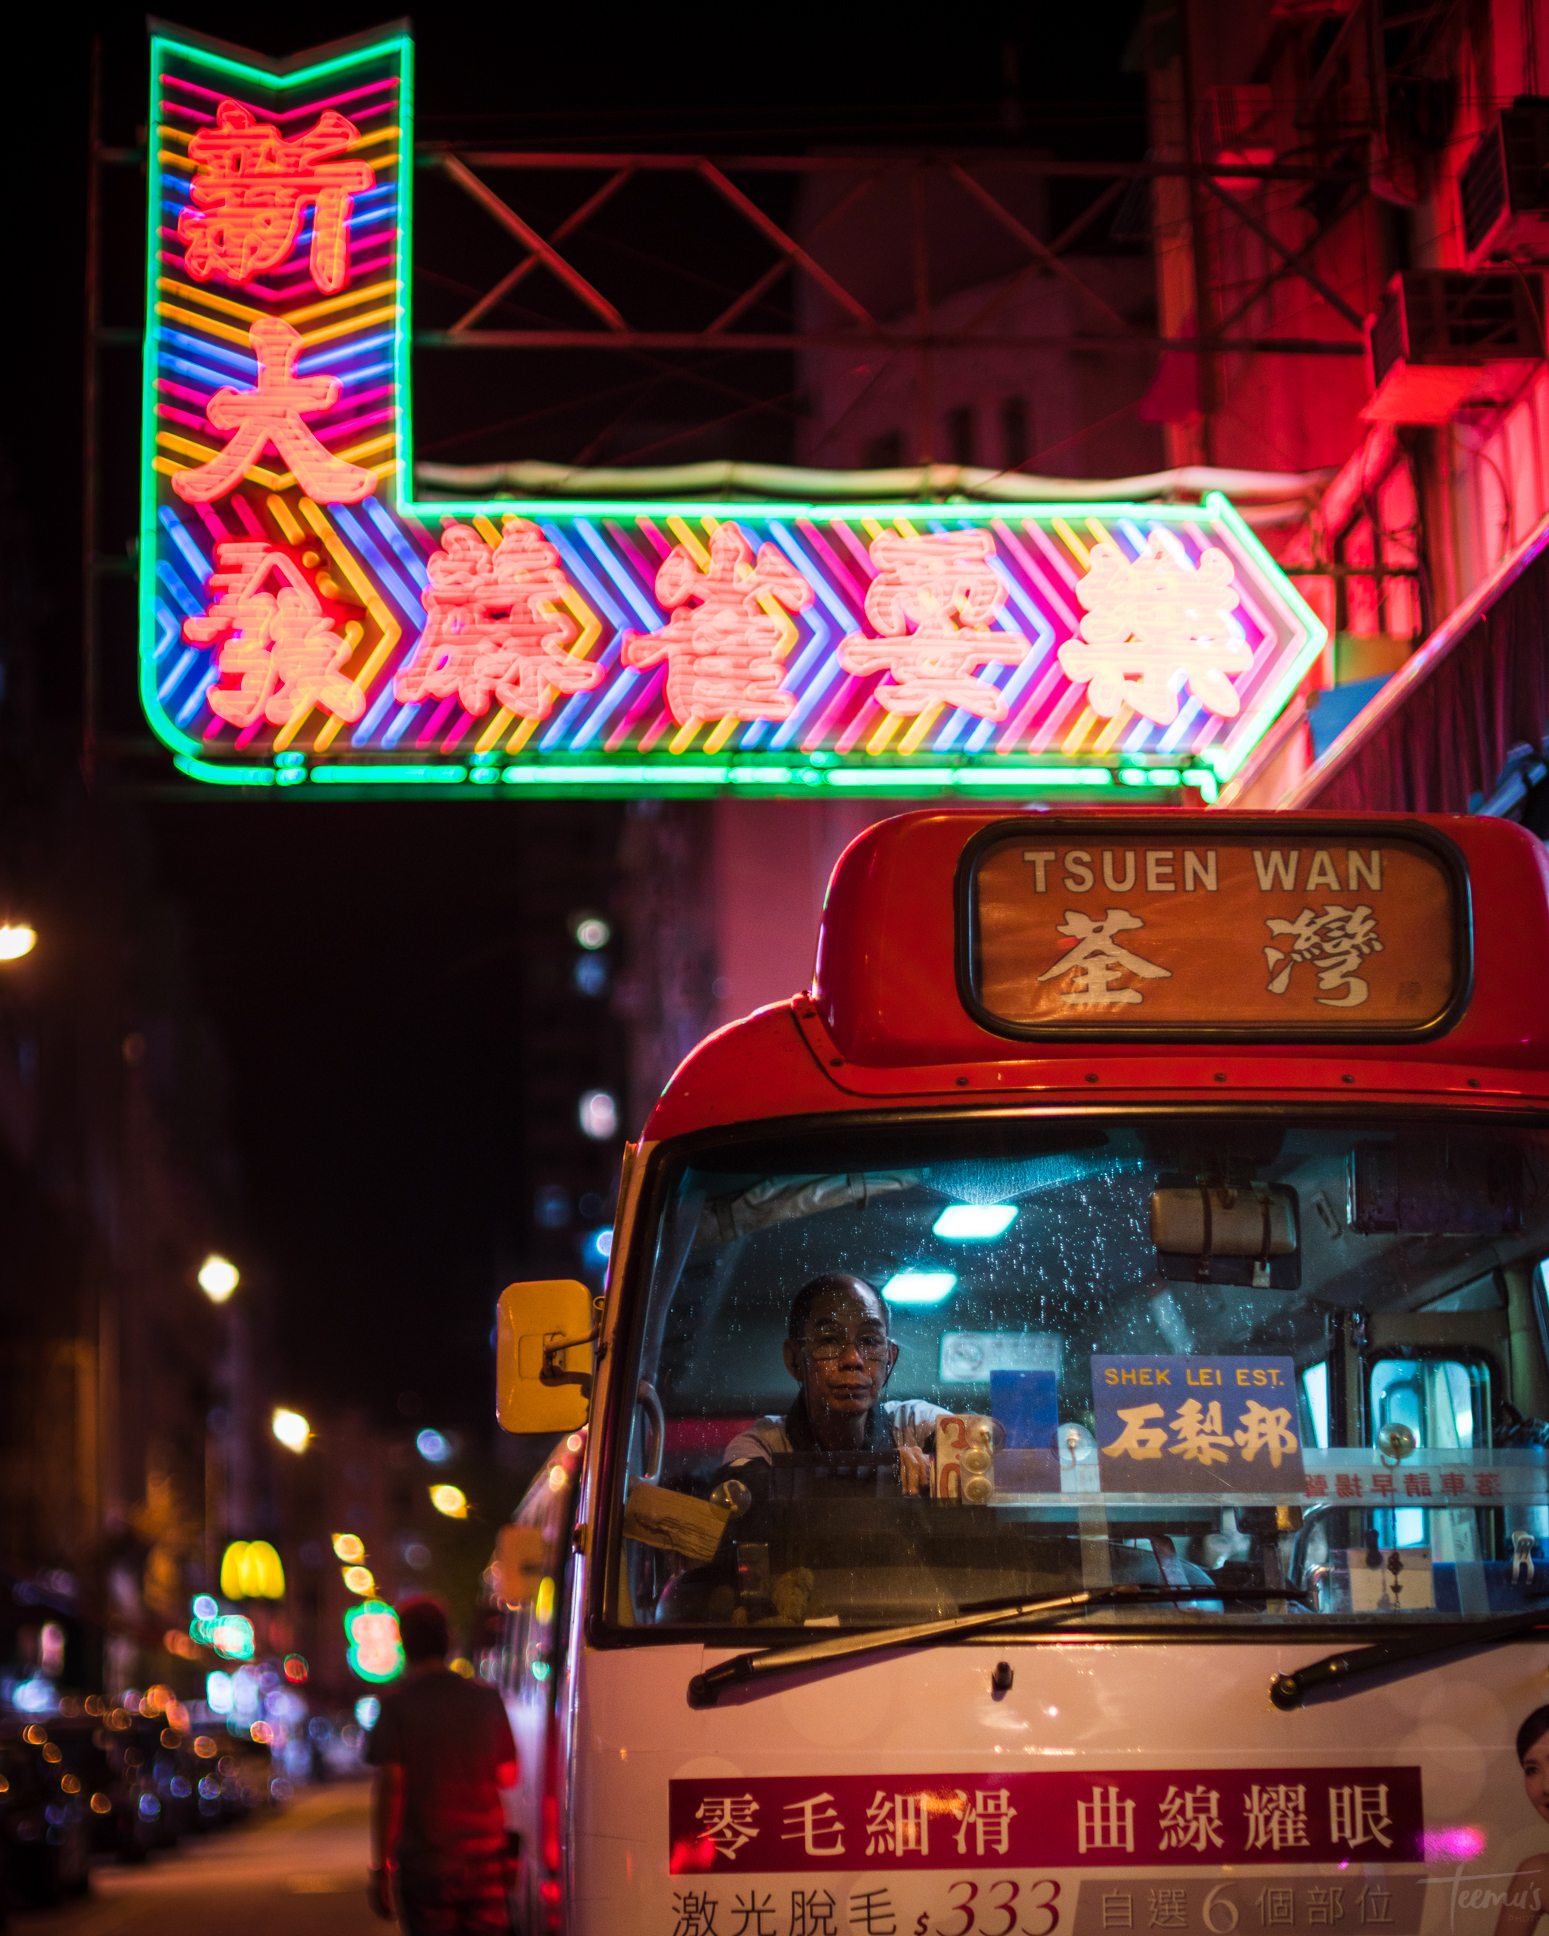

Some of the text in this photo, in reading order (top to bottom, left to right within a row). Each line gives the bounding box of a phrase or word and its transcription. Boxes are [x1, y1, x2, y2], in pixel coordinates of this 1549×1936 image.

[1023, 849, 1383, 893] TSUEN WAN
[1036, 904, 1385, 1008] 荃灣
[1104, 1367, 1285, 1386] SHEK LEI EST.
[695, 1784, 1395, 1861] 零毛細滑 曲線耀眼
